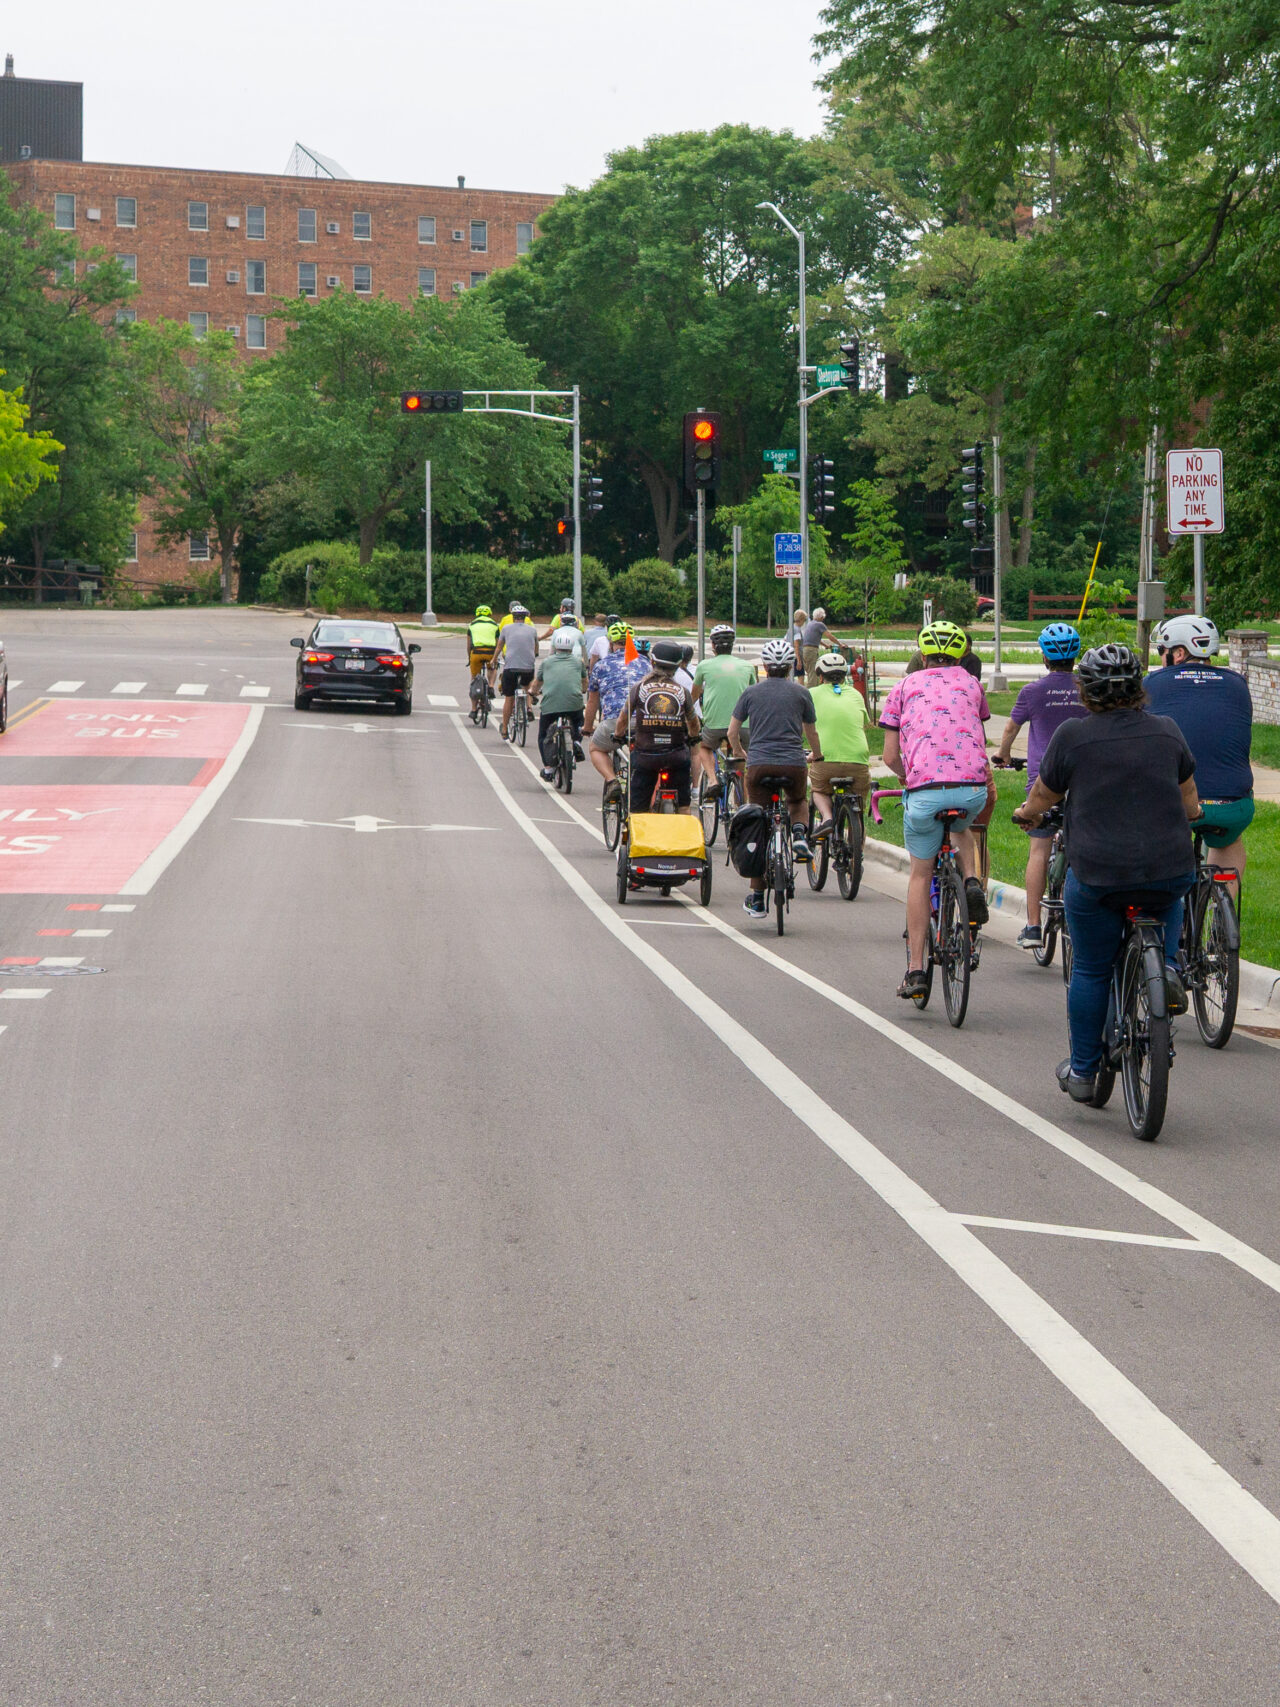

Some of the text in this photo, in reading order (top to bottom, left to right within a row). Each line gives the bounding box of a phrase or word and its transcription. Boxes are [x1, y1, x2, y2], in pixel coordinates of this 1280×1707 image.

[771, 451, 788, 460] Segoe
[1186, 456, 1203, 472] NO
[1172, 474, 1218, 488] PARKING
[1185, 489, 1206, 502] ANY
[1183, 503, 1207, 516] TIME
[777, 544, 783, 552] R
[643, 682, 681, 691] NEVER
[65, 712, 208, 724] ONLY
[641, 719, 683, 727] BICYCLE
[74, 727, 183, 739] BUS
